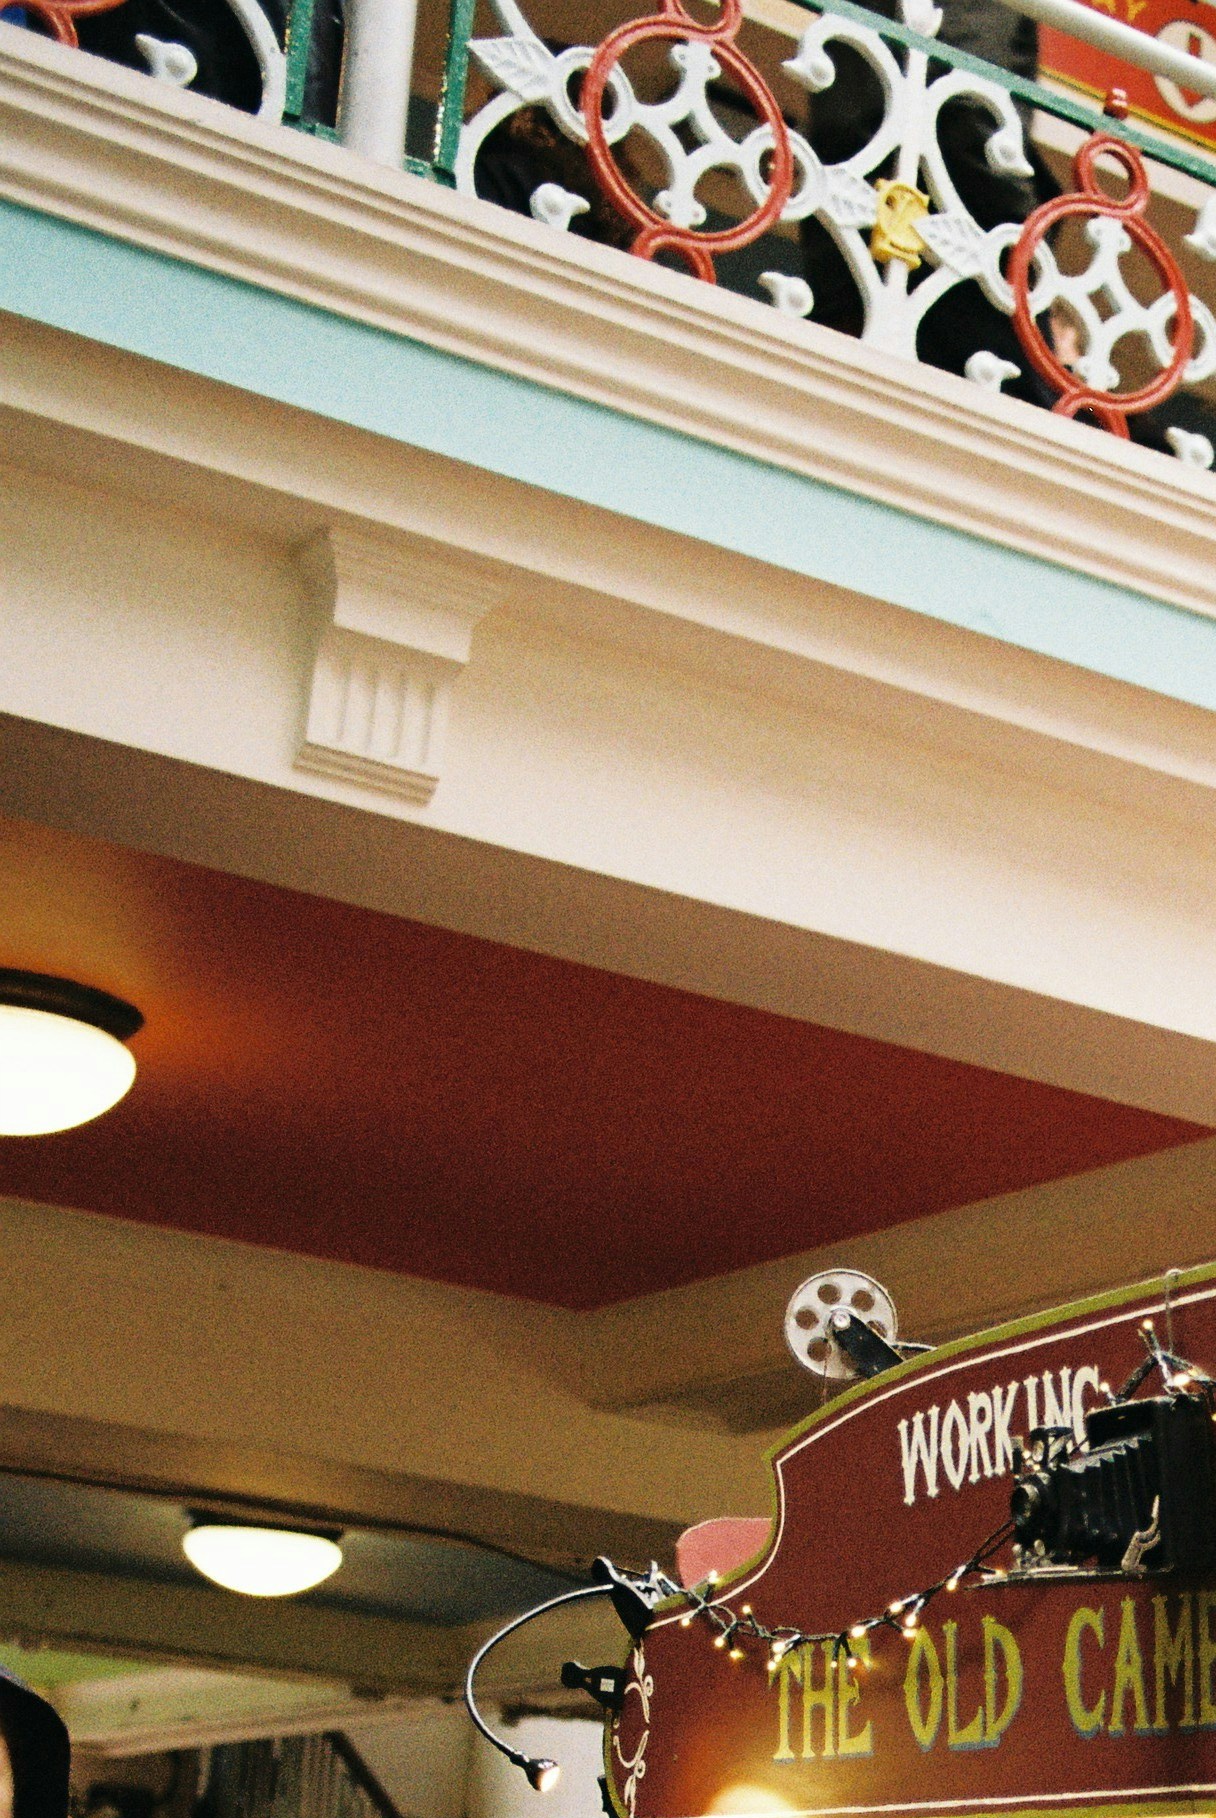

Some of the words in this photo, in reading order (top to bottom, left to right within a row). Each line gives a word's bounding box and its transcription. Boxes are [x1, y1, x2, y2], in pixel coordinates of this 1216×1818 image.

[897, 1366, 1100, 1507] WORKING
[768, 1638, 874, 1764] THE
[903, 1614, 1024, 1752] OLD
